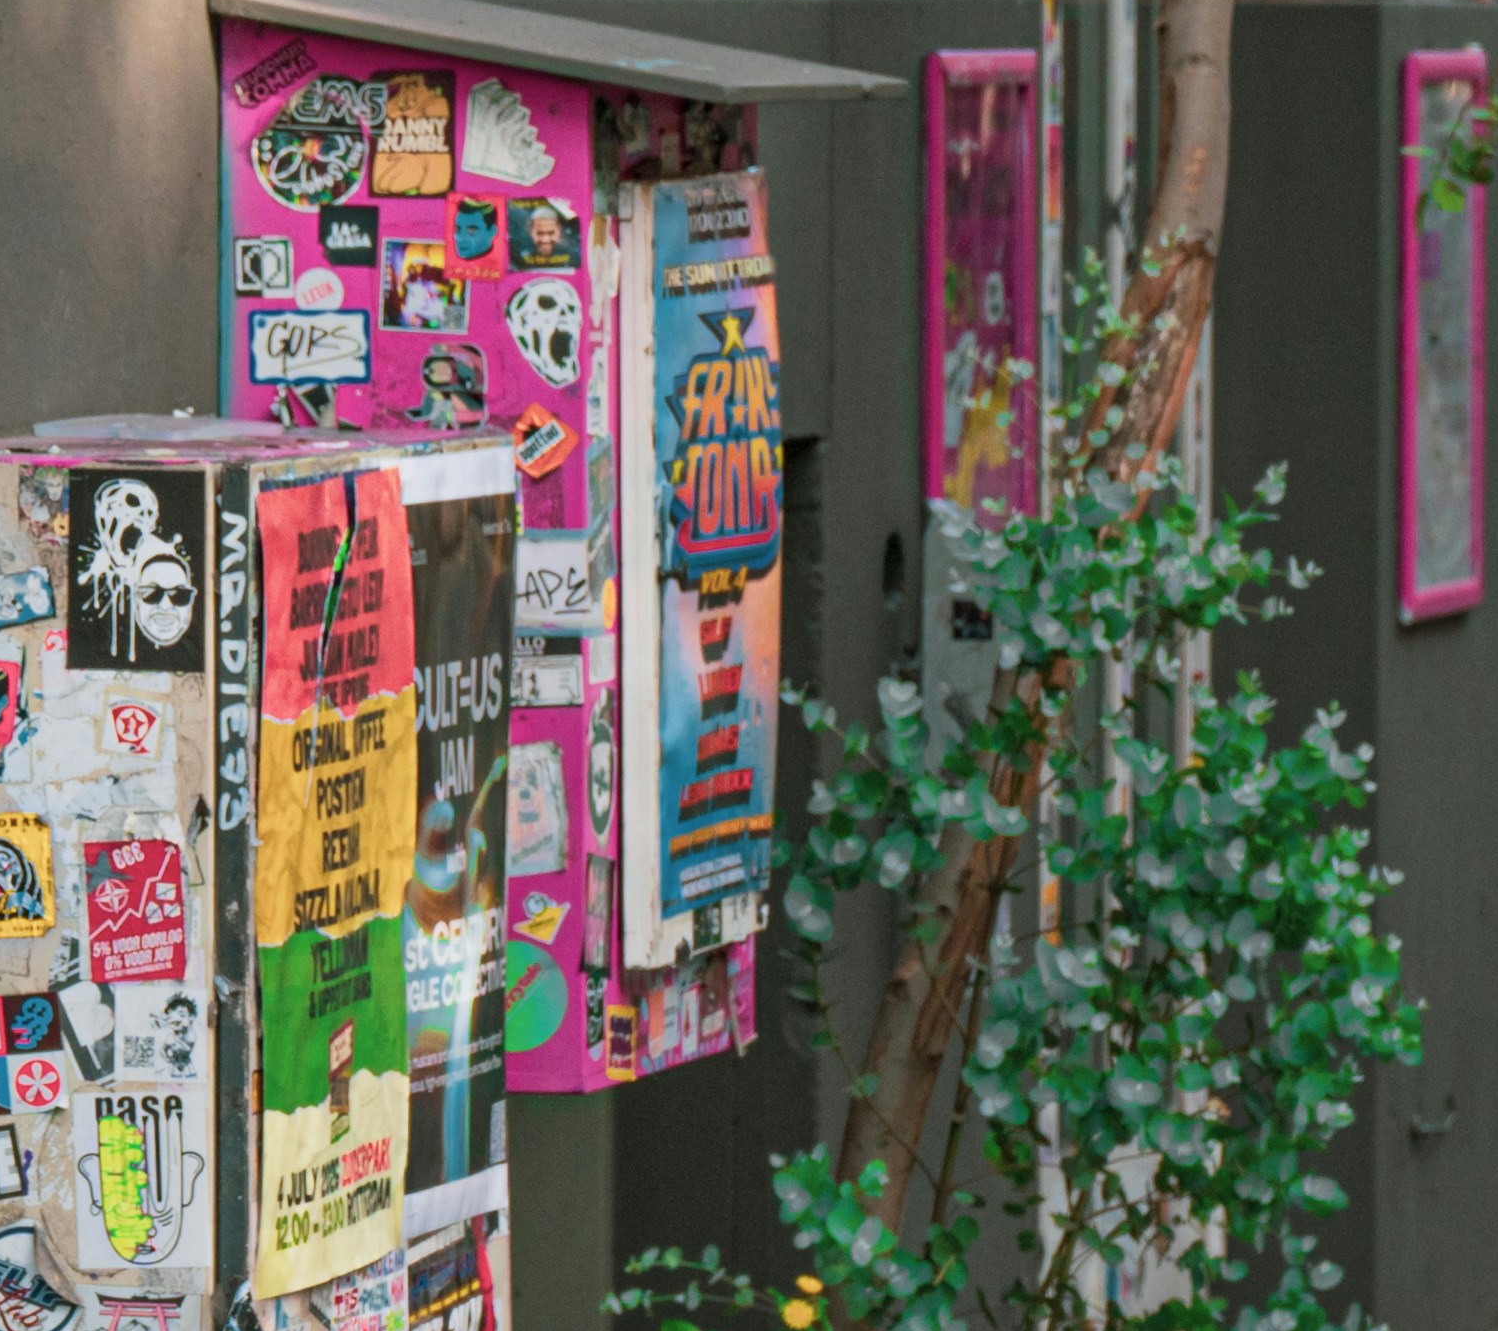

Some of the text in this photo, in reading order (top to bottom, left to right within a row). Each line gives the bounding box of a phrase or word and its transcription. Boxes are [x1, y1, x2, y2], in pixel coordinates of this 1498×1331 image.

[301, 281, 336, 307] LEUK
[435, 735, 475, 800] JAM
[112, 934, 141, 954] VOOR
[142, 928, 183, 948] OORLOG
[124, 948, 152, 968] VOOR
[287, 1166, 319, 1208] JULY
